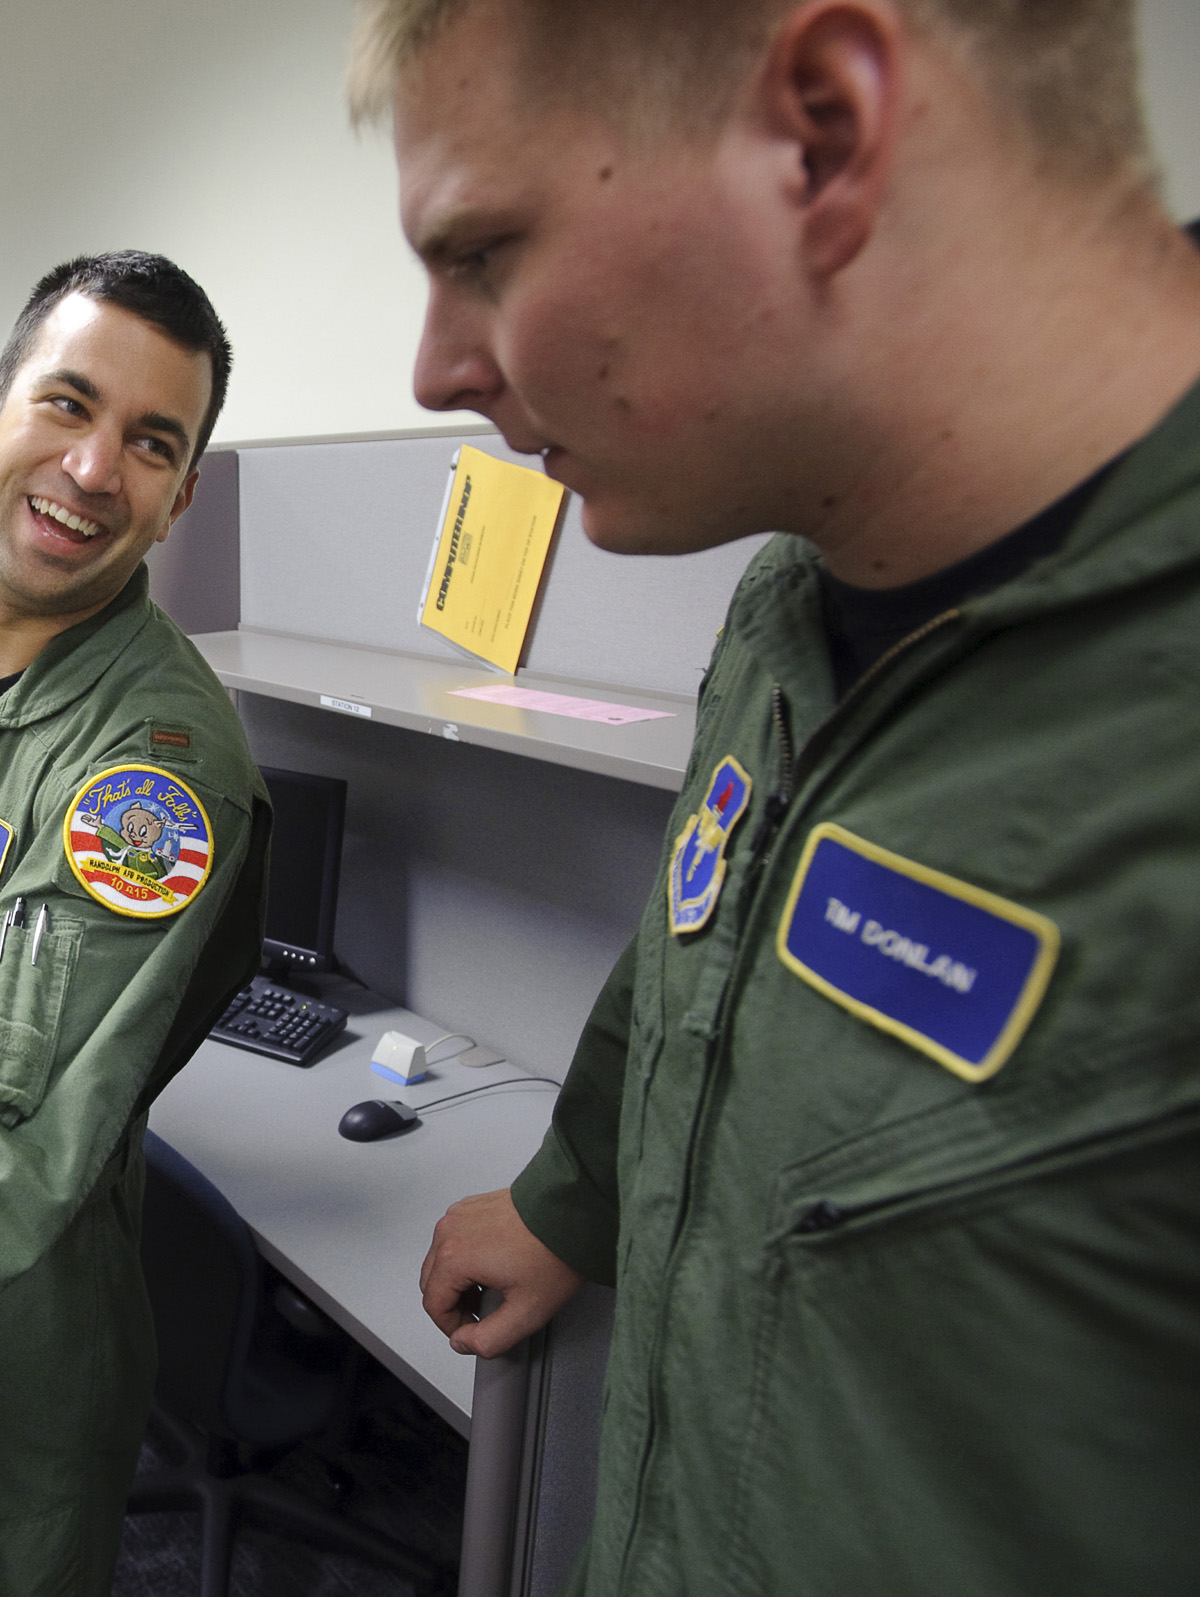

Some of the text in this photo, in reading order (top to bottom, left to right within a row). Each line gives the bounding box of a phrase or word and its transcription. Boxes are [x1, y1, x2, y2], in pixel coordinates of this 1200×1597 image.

[436, 518, 464, 611] COMPUTER
[331, 699, 353, 711] STATION
[135, 779, 155, 796] all
[89, 859, 170, 896] RANDOLPH AFB PRODUCTION
[111, 876, 124, 891] 10
[823, 897, 978, 994] TIM DONLAN
